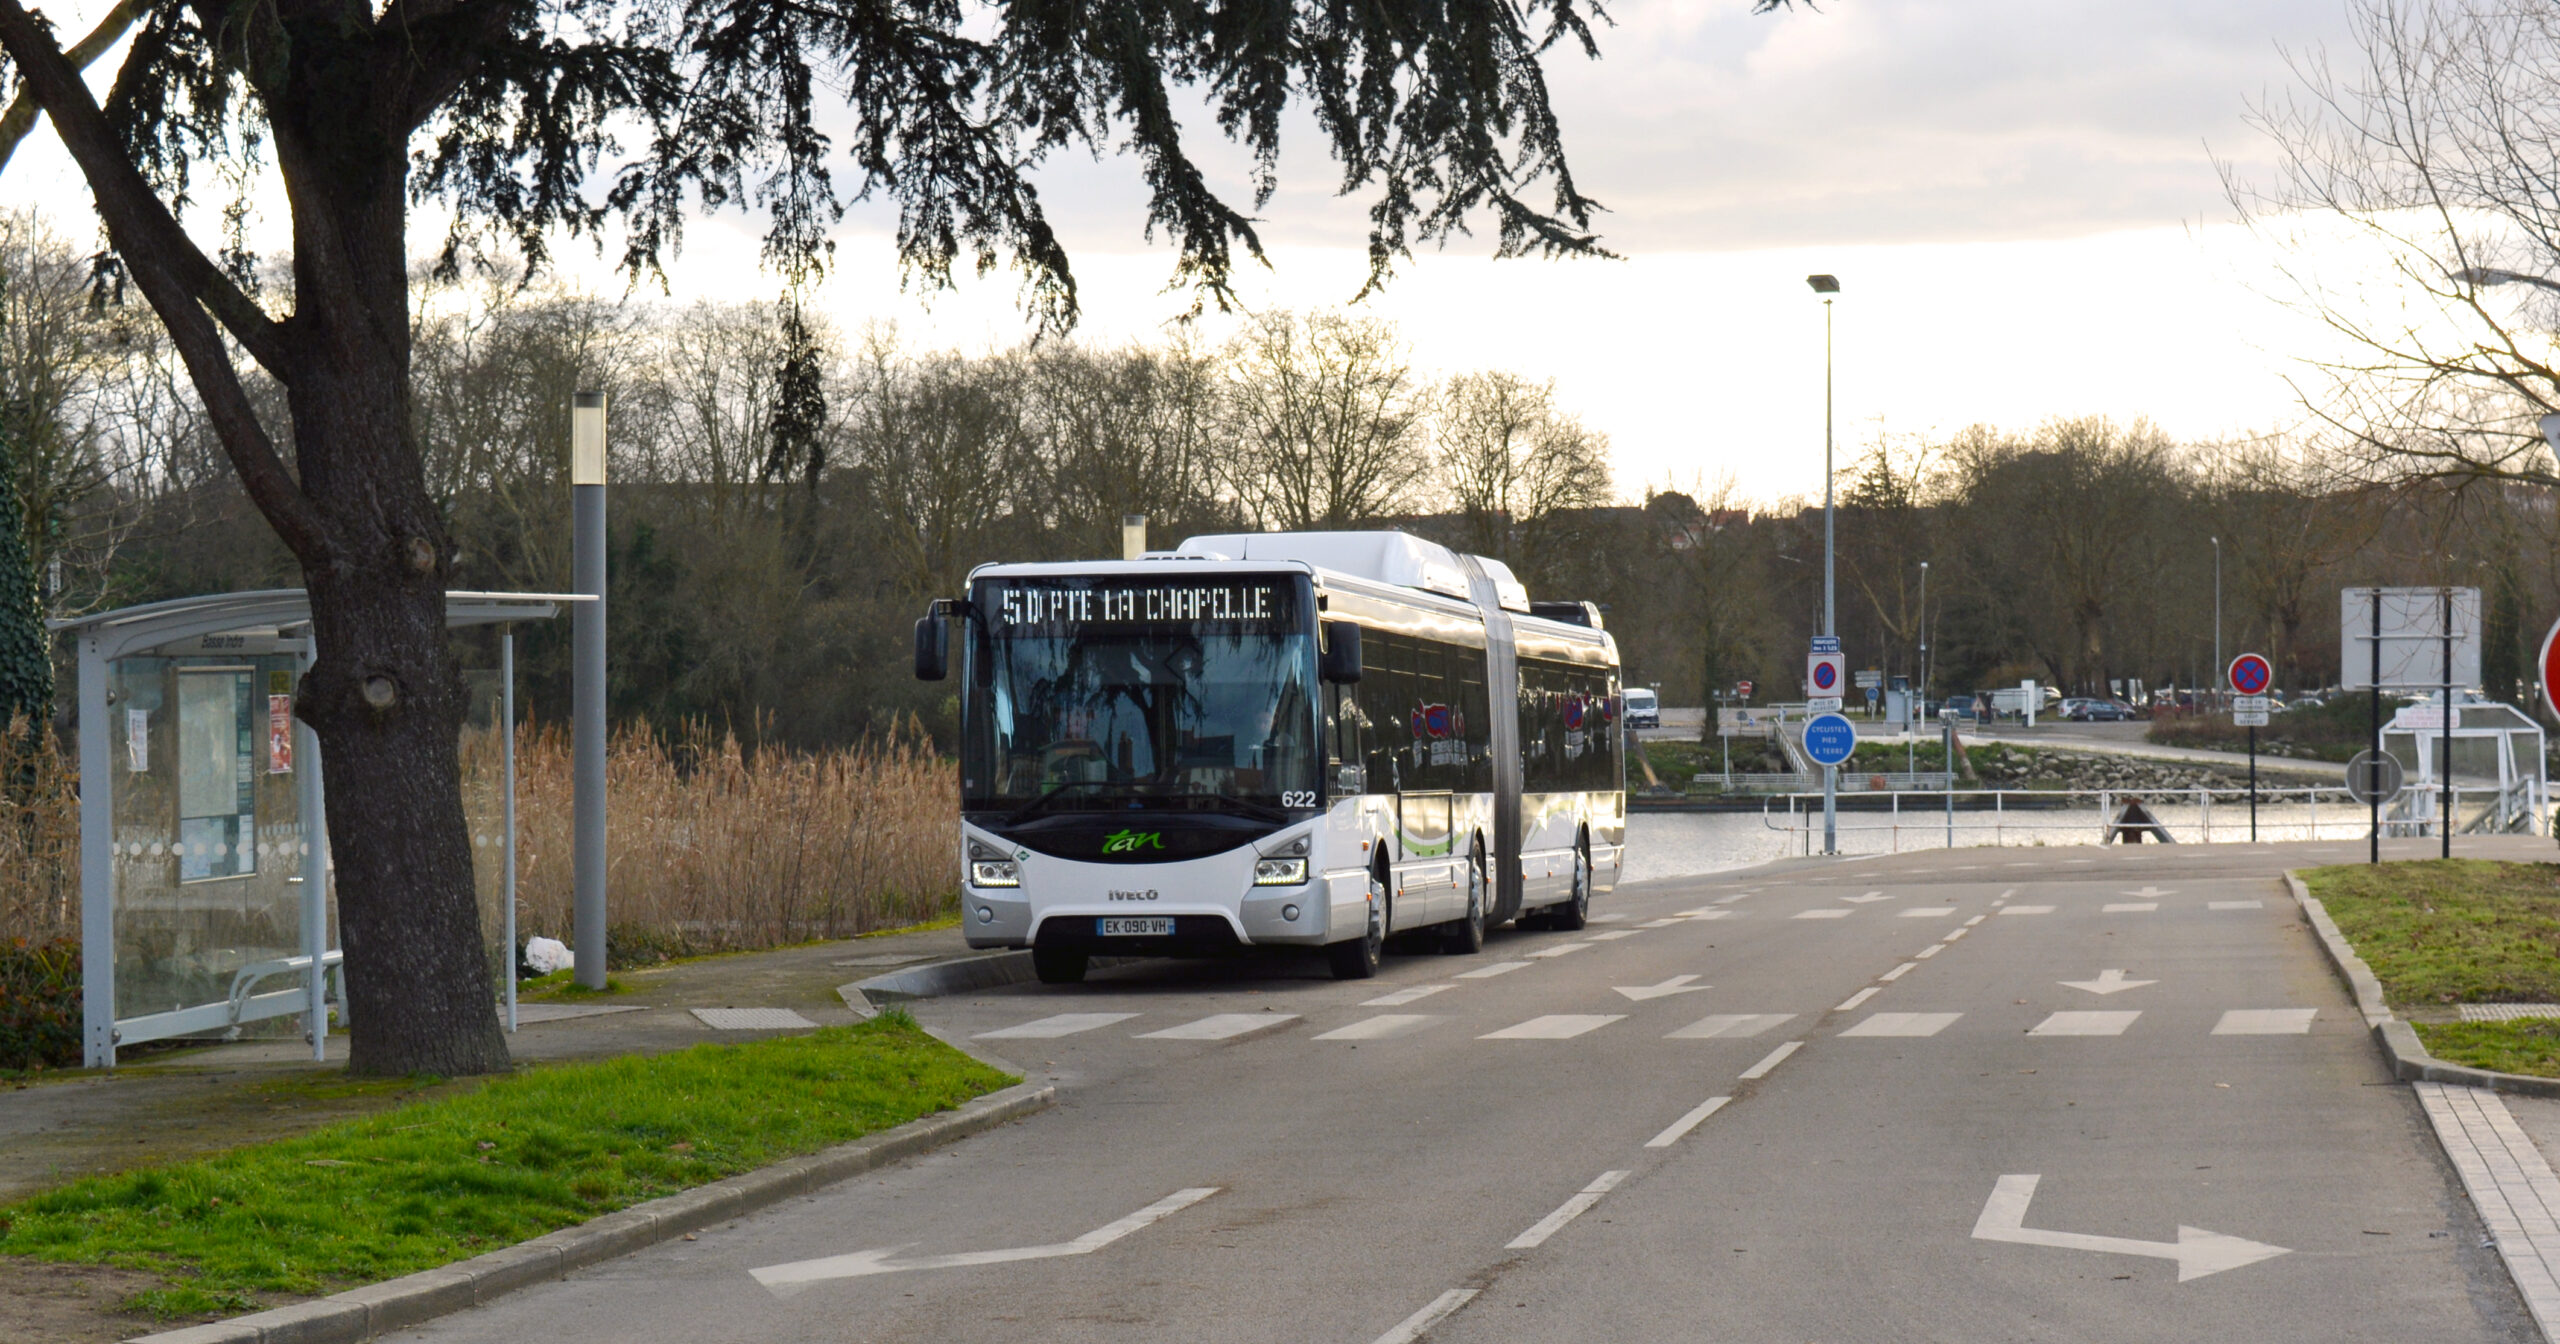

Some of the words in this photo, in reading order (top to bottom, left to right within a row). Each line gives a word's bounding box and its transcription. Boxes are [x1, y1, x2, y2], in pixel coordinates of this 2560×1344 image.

[1050, 589, 1092, 621] PTE
[1105, 589, 1134, 621] LA
[1146, 587, 1271, 620] CHAPELLE
[201, 633, 224, 649] Basse
[1822, 736, 1837, 744] PIED
[1823, 747, 1844, 755] TERRE
[1281, 790, 1316, 808] 622
[1102, 829, 1166, 854] tan
[1108, 889, 1159, 901] IVECO
[1105, 920, 1167, 934] EK-090-VH
